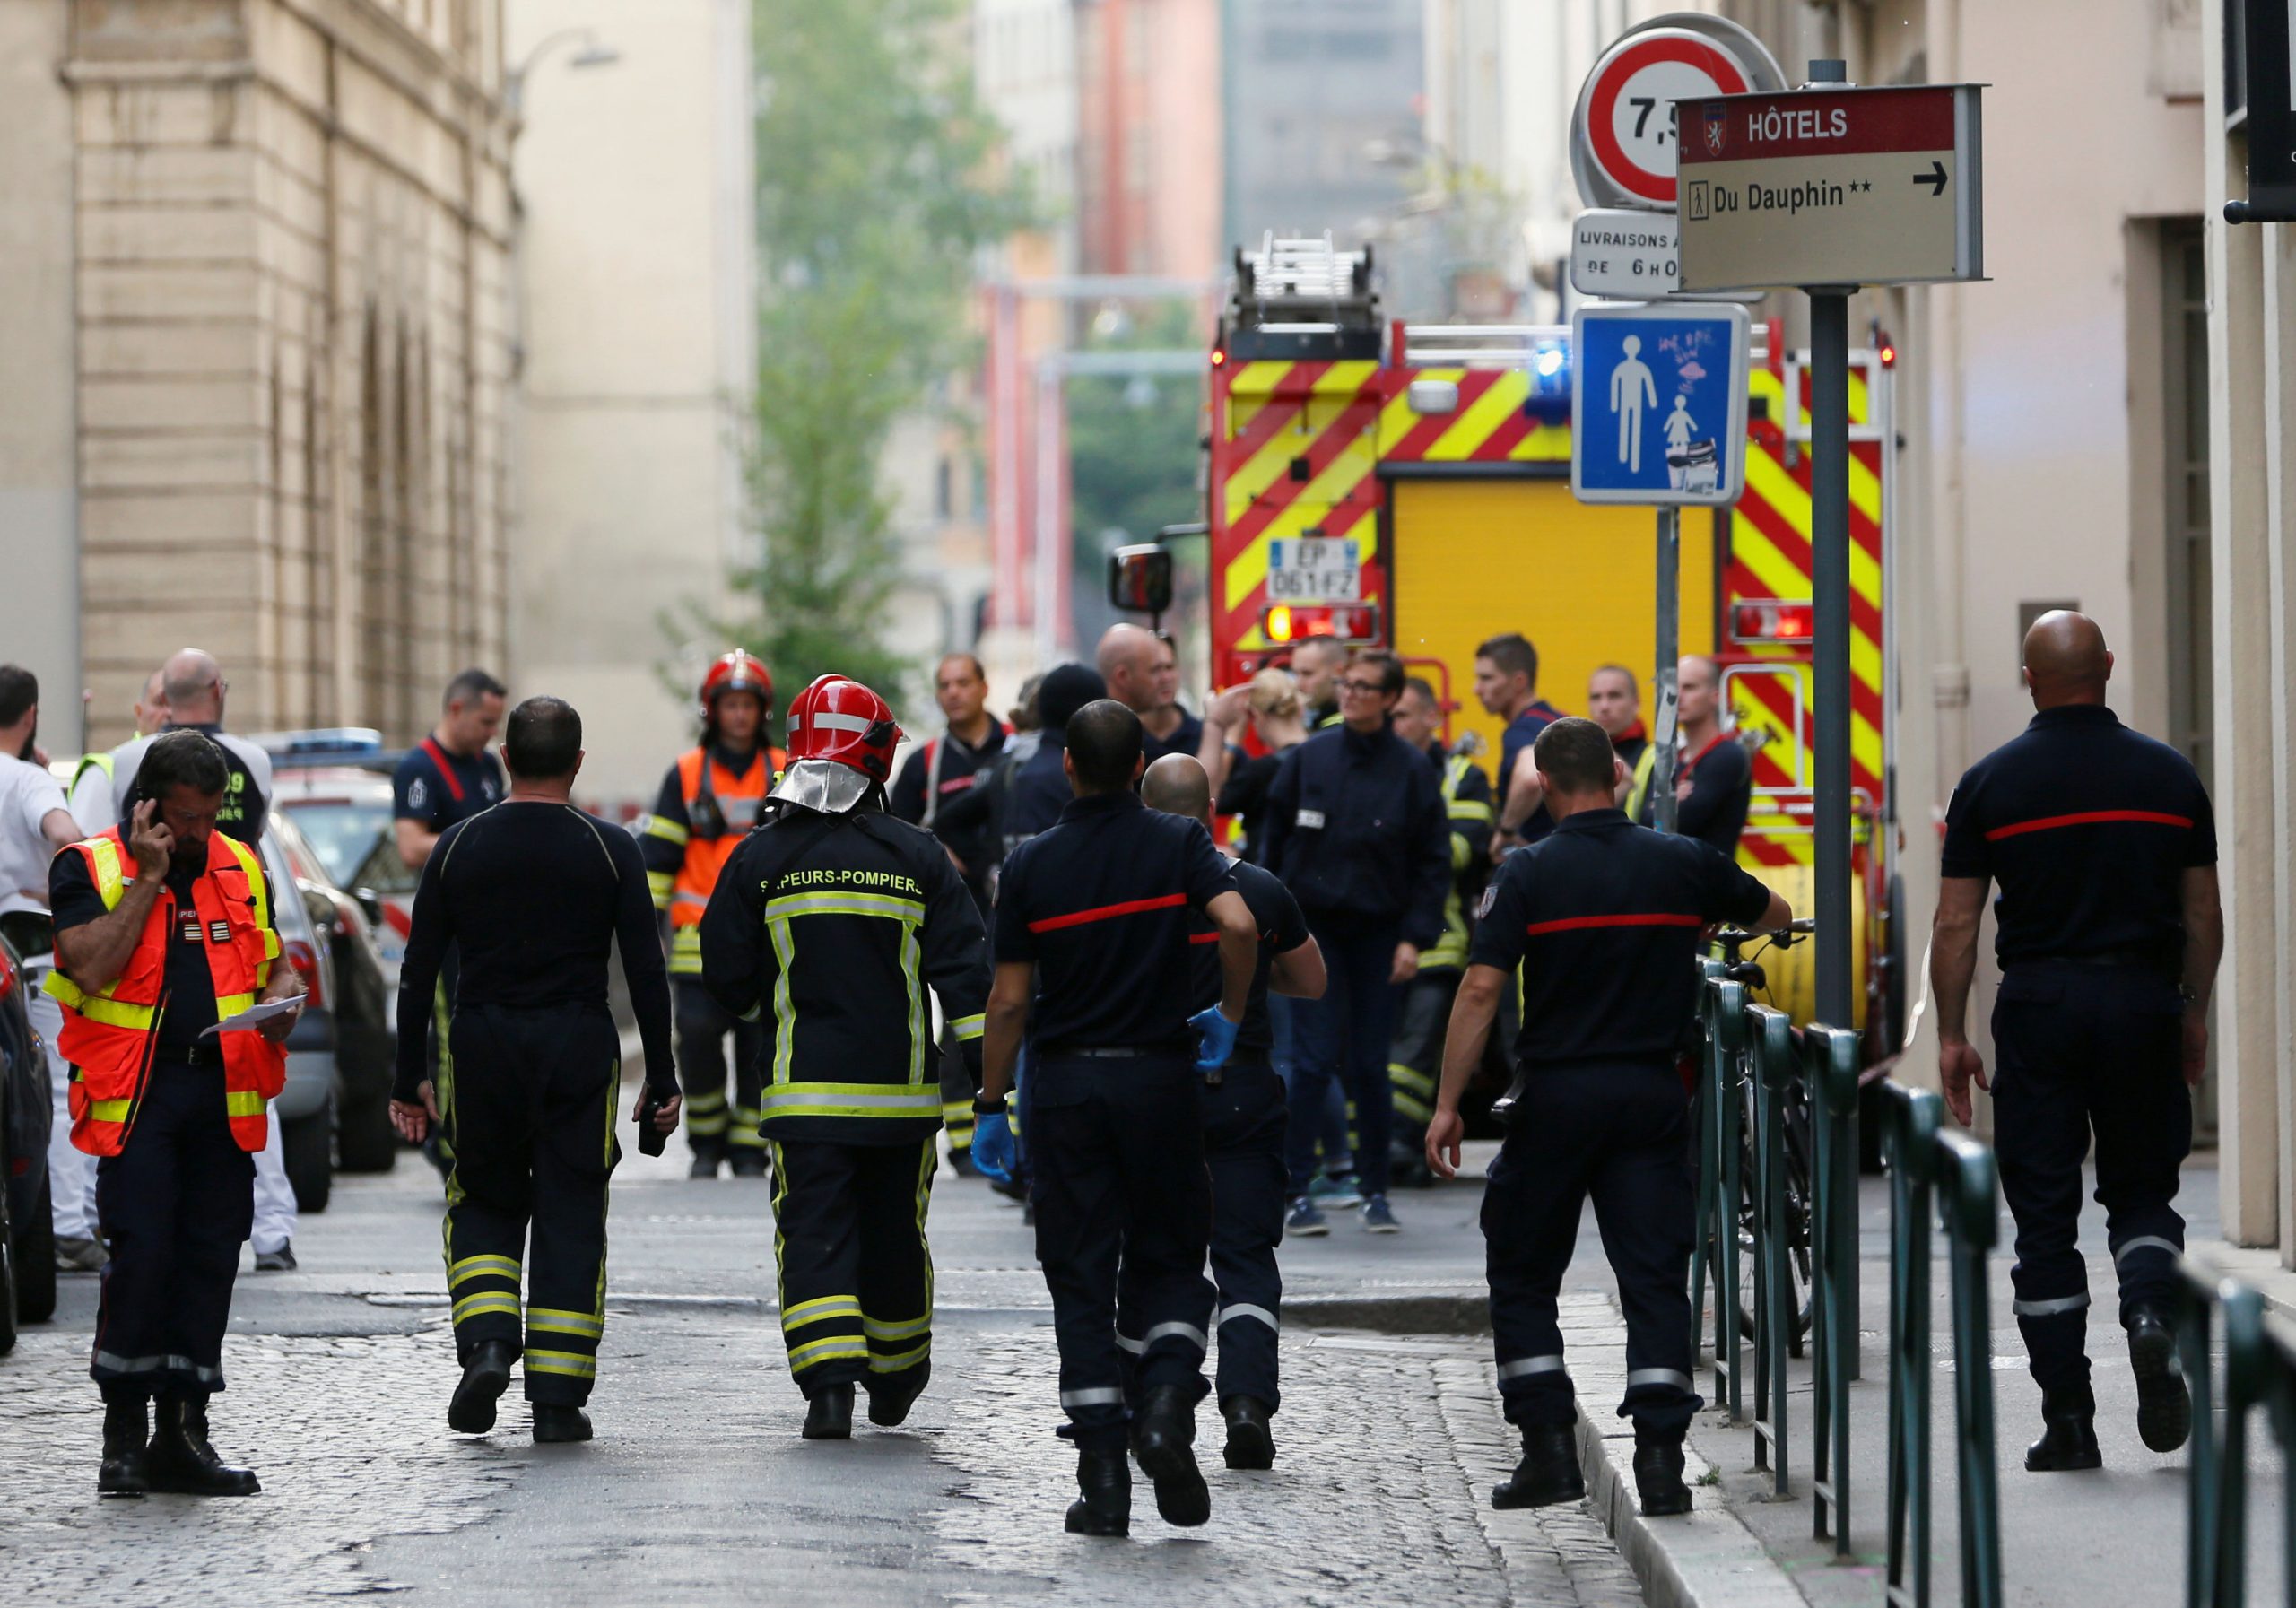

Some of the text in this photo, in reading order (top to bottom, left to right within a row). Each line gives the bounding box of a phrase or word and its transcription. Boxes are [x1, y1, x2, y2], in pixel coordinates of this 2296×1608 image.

[1748, 105, 1848, 142] HÔTELS
[1714, 179, 1844, 215] Du Dauphin
[1580, 231, 1667, 248] LIVRAISONS
[1587, 260, 1609, 274] DE
